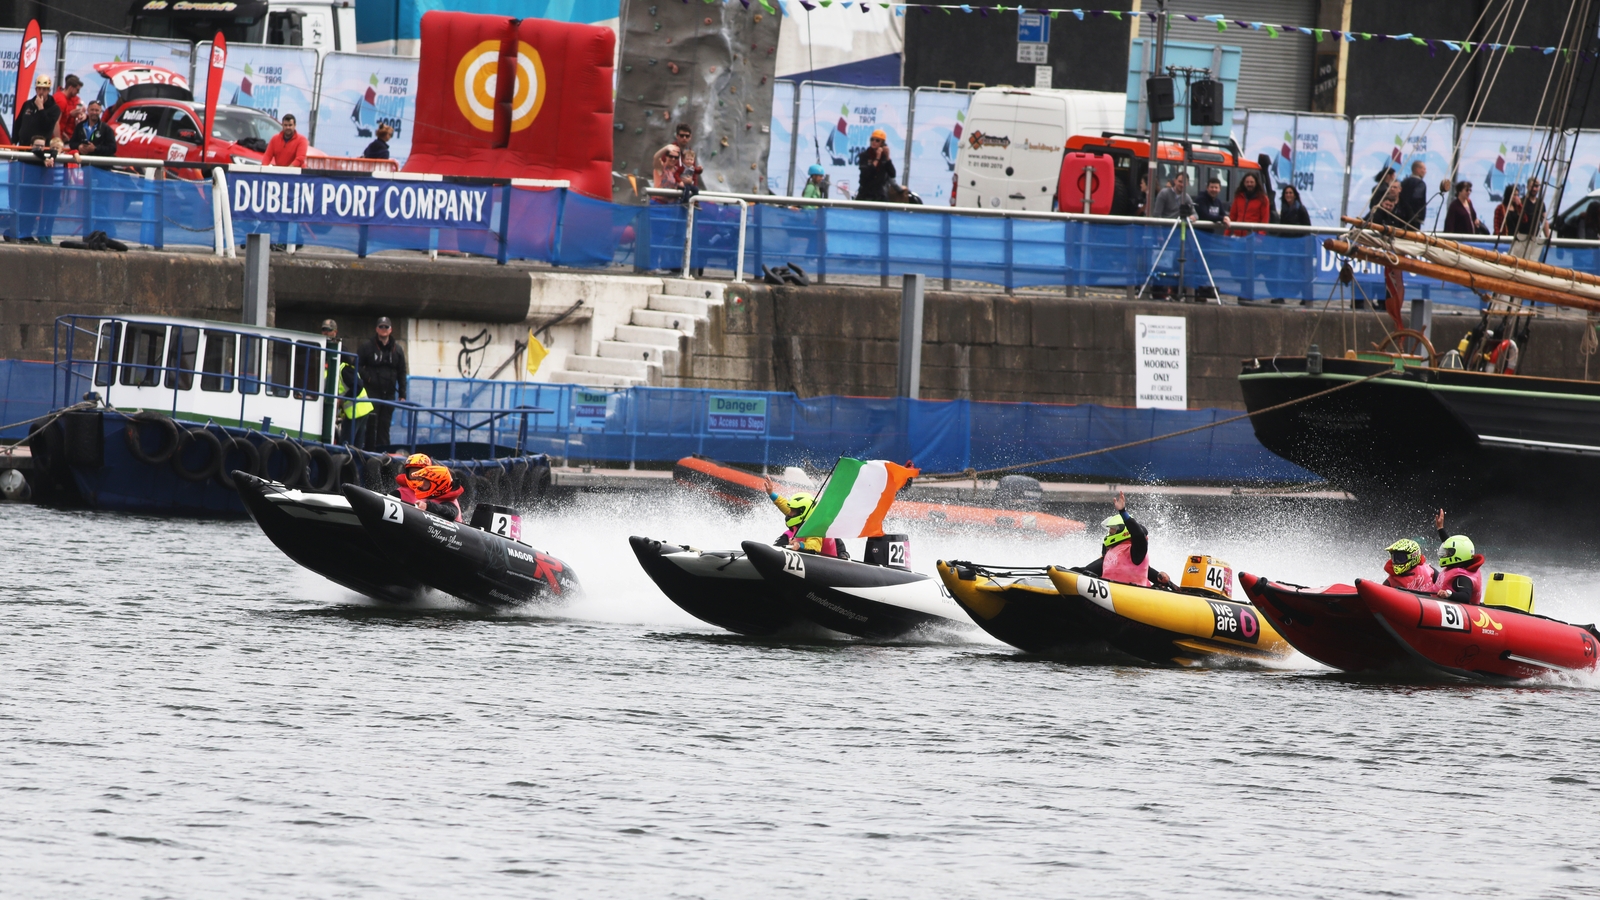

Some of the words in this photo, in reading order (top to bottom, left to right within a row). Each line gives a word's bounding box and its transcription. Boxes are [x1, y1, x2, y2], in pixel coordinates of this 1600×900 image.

[123, 109, 148, 121] Dublin's
[115, 122, 158, 145] 98FM
[234, 179, 315, 215] DUBLIN
[321, 183, 379, 217] PORT
[384, 186, 487, 222] COMPANY
[1142, 346, 1180, 356] TEMPORARY
[1144, 360, 1179, 369] MOORINGS
[1153, 373, 1170, 382] ONLY
[717, 398, 757, 413] Danger
[709, 417, 717, 425] No
[719, 417, 739, 427] Access
[740, 419, 746, 428] to
[748, 419, 764, 429] Steps
[389, 503, 399, 520] 2
[497, 516, 508, 535] 2
[507, 547, 535, 563] MAGOR
[786, 552, 804, 571] 22
[890, 544, 905, 564] 22
[1207, 567, 1223, 589] 46
[1087, 578, 1108, 599] 46
[806, 591, 869, 623] thundercatracing.com
[1210, 602, 1233, 617] we
[1444, 604, 1459, 625] 51
[1217, 616, 1237, 633] are
